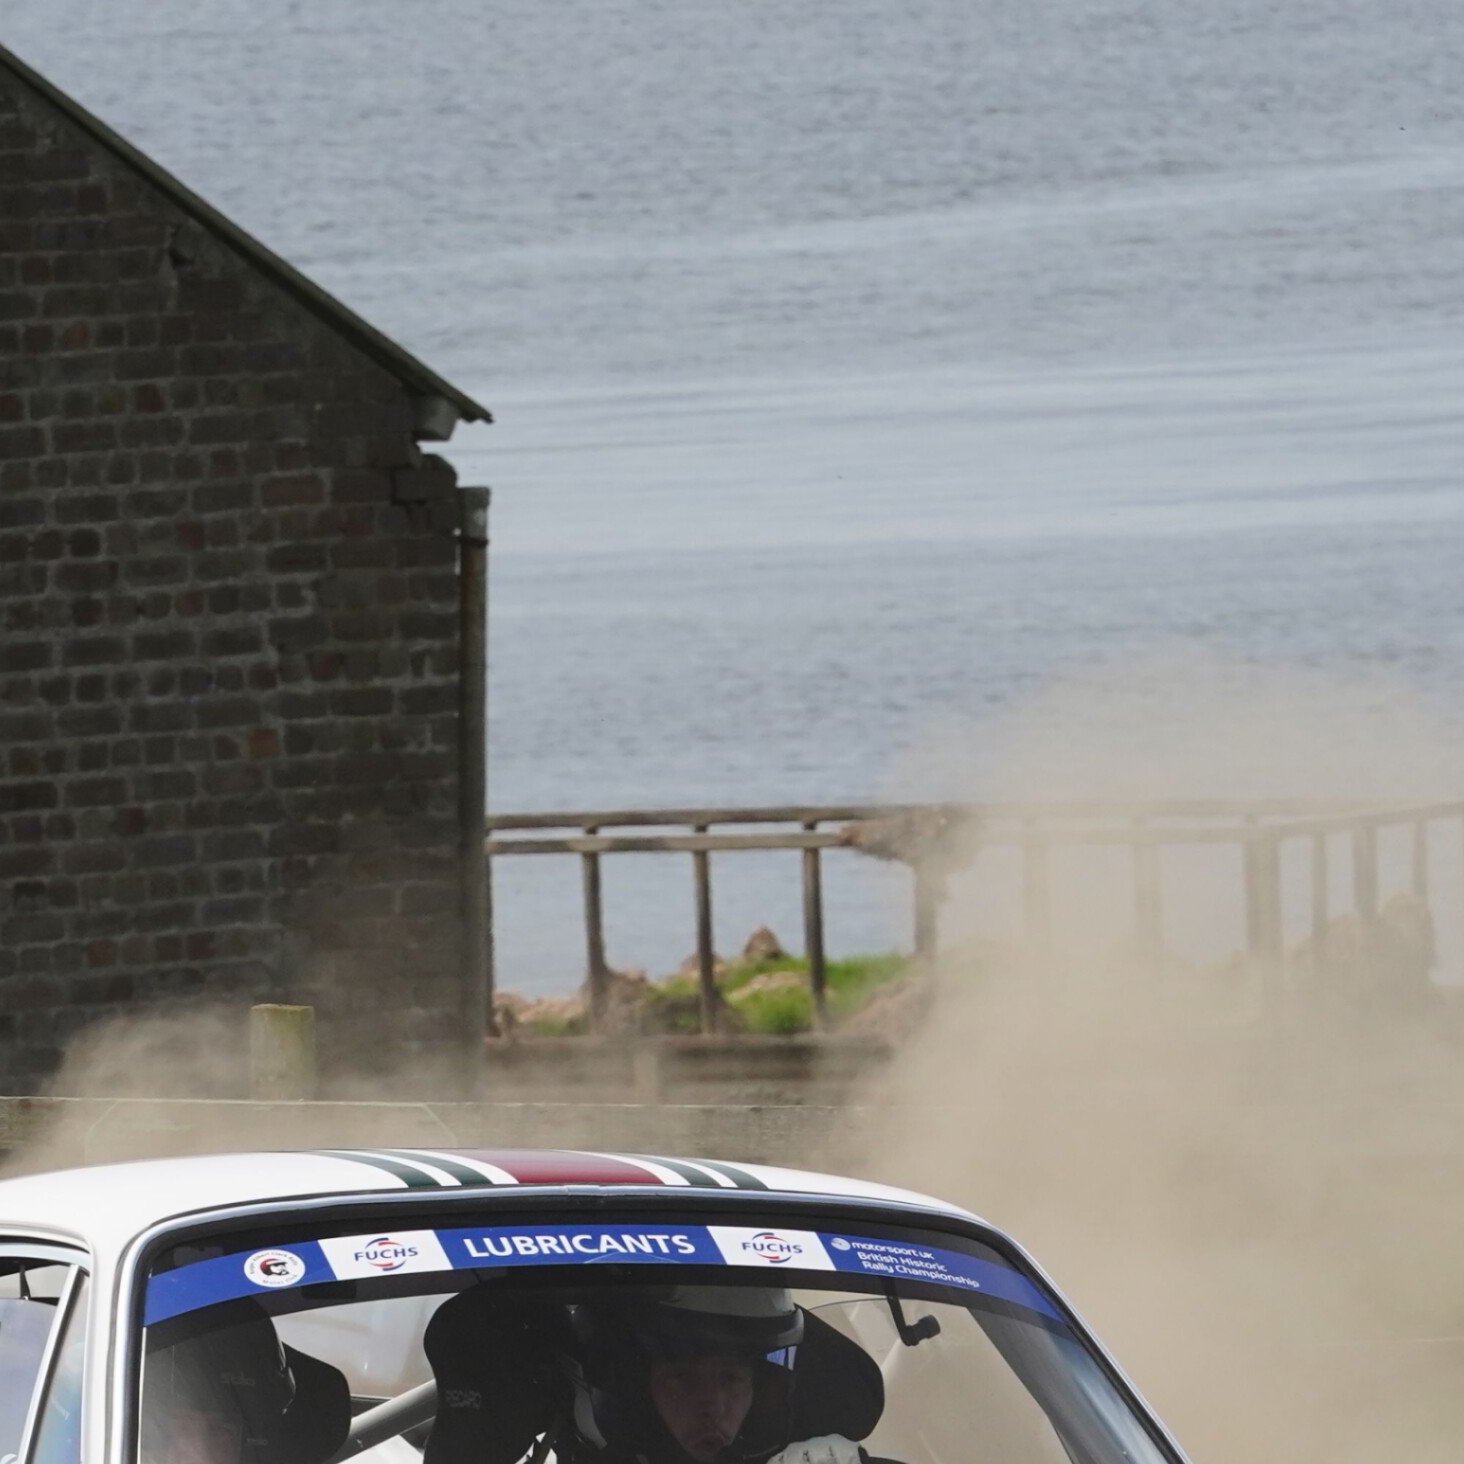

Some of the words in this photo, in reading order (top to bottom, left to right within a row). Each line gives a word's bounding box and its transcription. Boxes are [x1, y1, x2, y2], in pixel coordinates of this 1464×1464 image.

[354, 1246, 418, 1262] FUCHS
[463, 1234, 696, 1258] LUBRICANTS
[741, 1241, 803, 1254] FUCHS
[851, 1241, 918, 1257] motorsport
[857, 1251, 898, 1264] British
[900, 1256, 948, 1272] Historic
[862, 1260, 894, 1274] Rally
[896, 1264, 980, 1288] Championship
